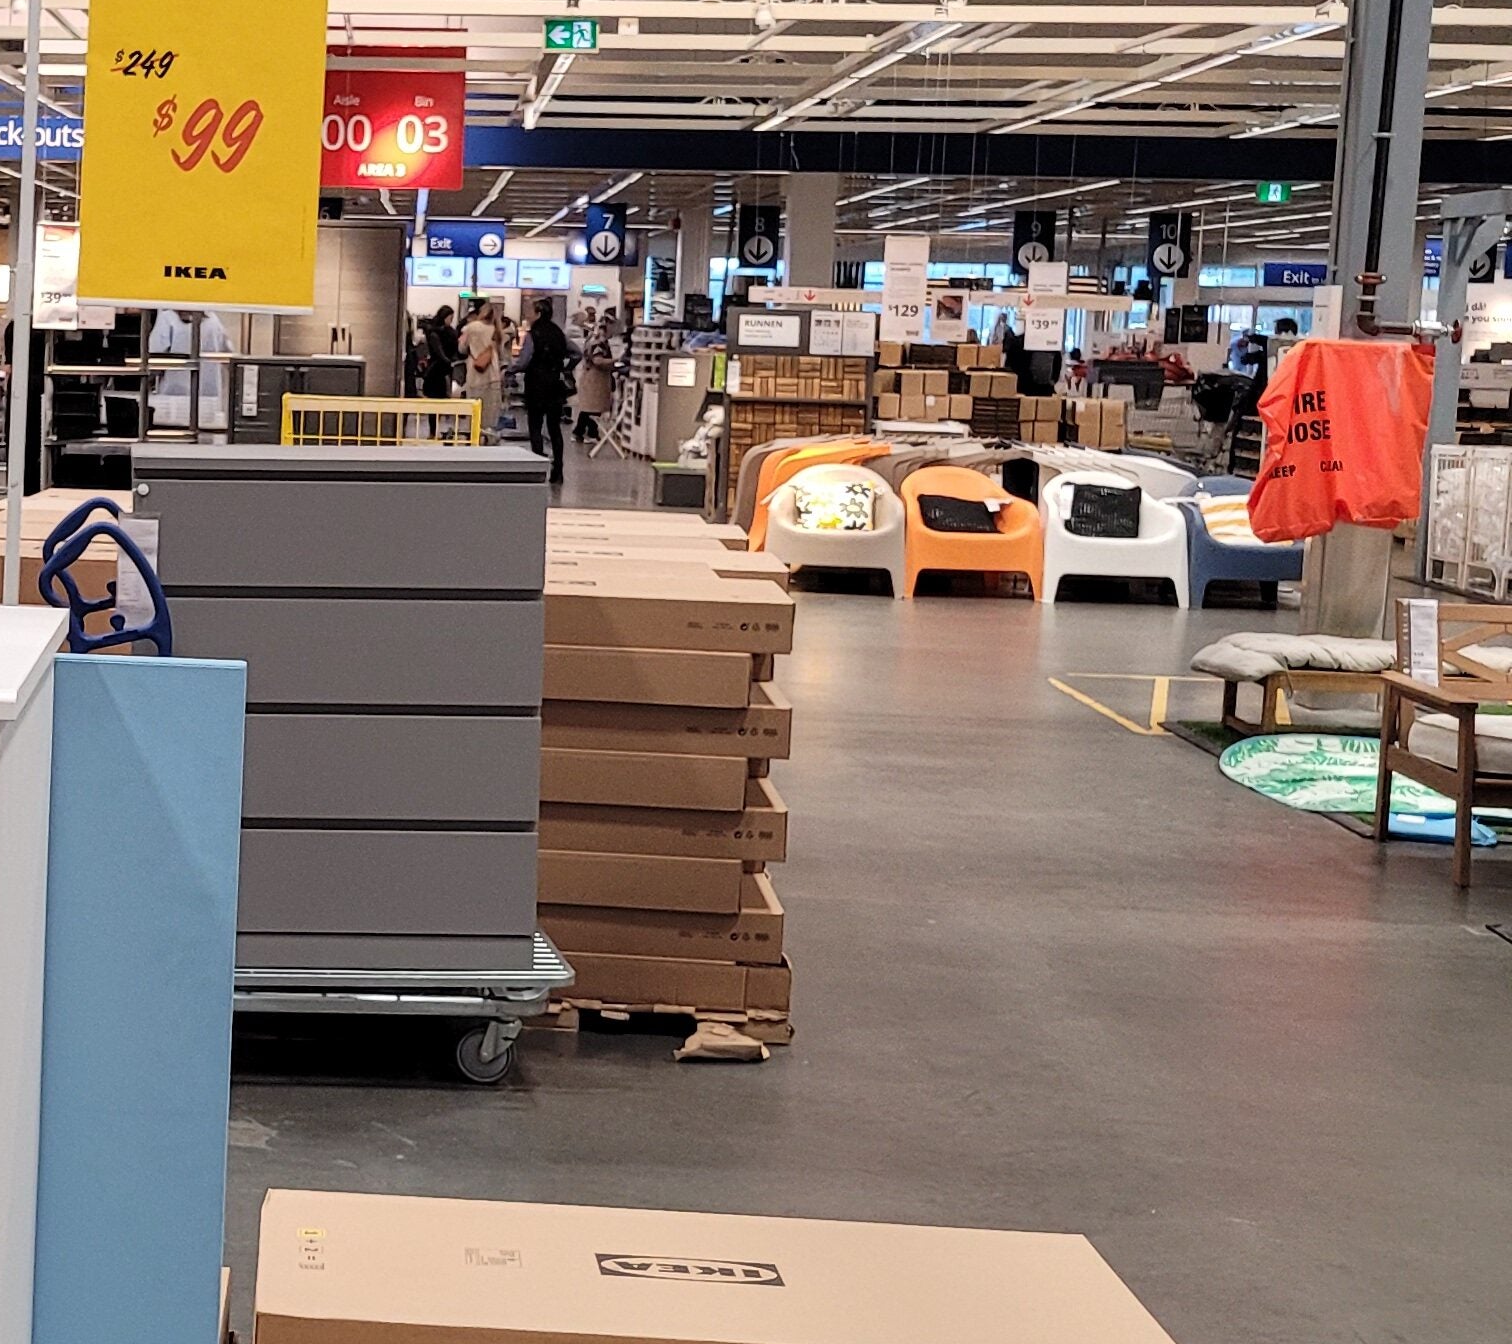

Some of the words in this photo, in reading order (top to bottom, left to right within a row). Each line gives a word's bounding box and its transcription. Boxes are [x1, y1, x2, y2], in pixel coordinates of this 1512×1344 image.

[333, 94, 360, 106] Aisle
[152, 94, 265, 174] $99
[396, 113, 449, 154] 03
[602, 213, 615, 230] 7
[754, 217, 766, 233] 8
[1031, 220, 1042, 238] 9
[1159, 223, 1178, 240] 10
[429, 237, 452, 250] Exit
[163, 265, 228, 282] IKEA
[1282, 269, 1310, 285] Exit
[744, 319, 783, 329] RUNNEN
[1294, 390, 1327, 415] IRE
[612, 1260, 763, 1279] IKEA
